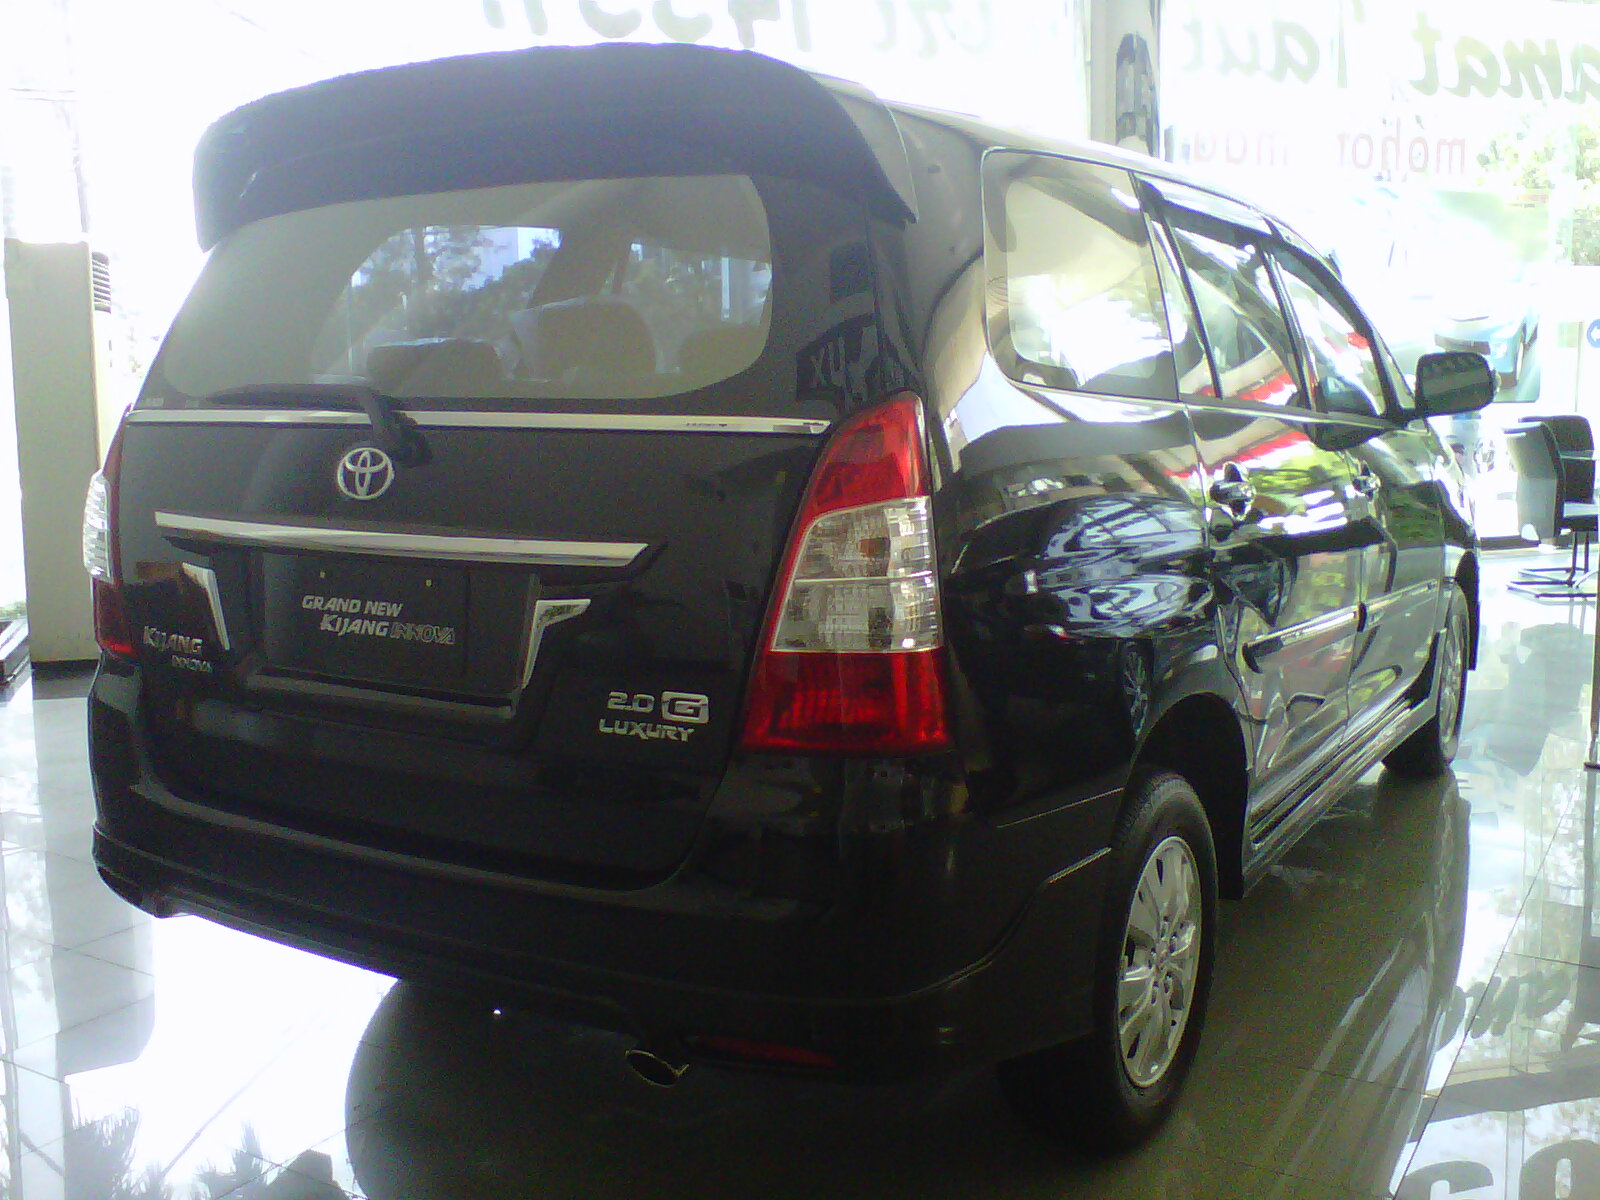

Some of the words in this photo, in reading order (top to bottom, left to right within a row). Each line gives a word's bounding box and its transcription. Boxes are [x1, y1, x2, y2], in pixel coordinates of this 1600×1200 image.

[302, 594, 361, 614] GRAND
[364, 600, 404, 617] NEW
[607, 690, 655, 713] 2.0
[660, 690, 710, 725] G
[598, 717, 696, 743] LUXURY
